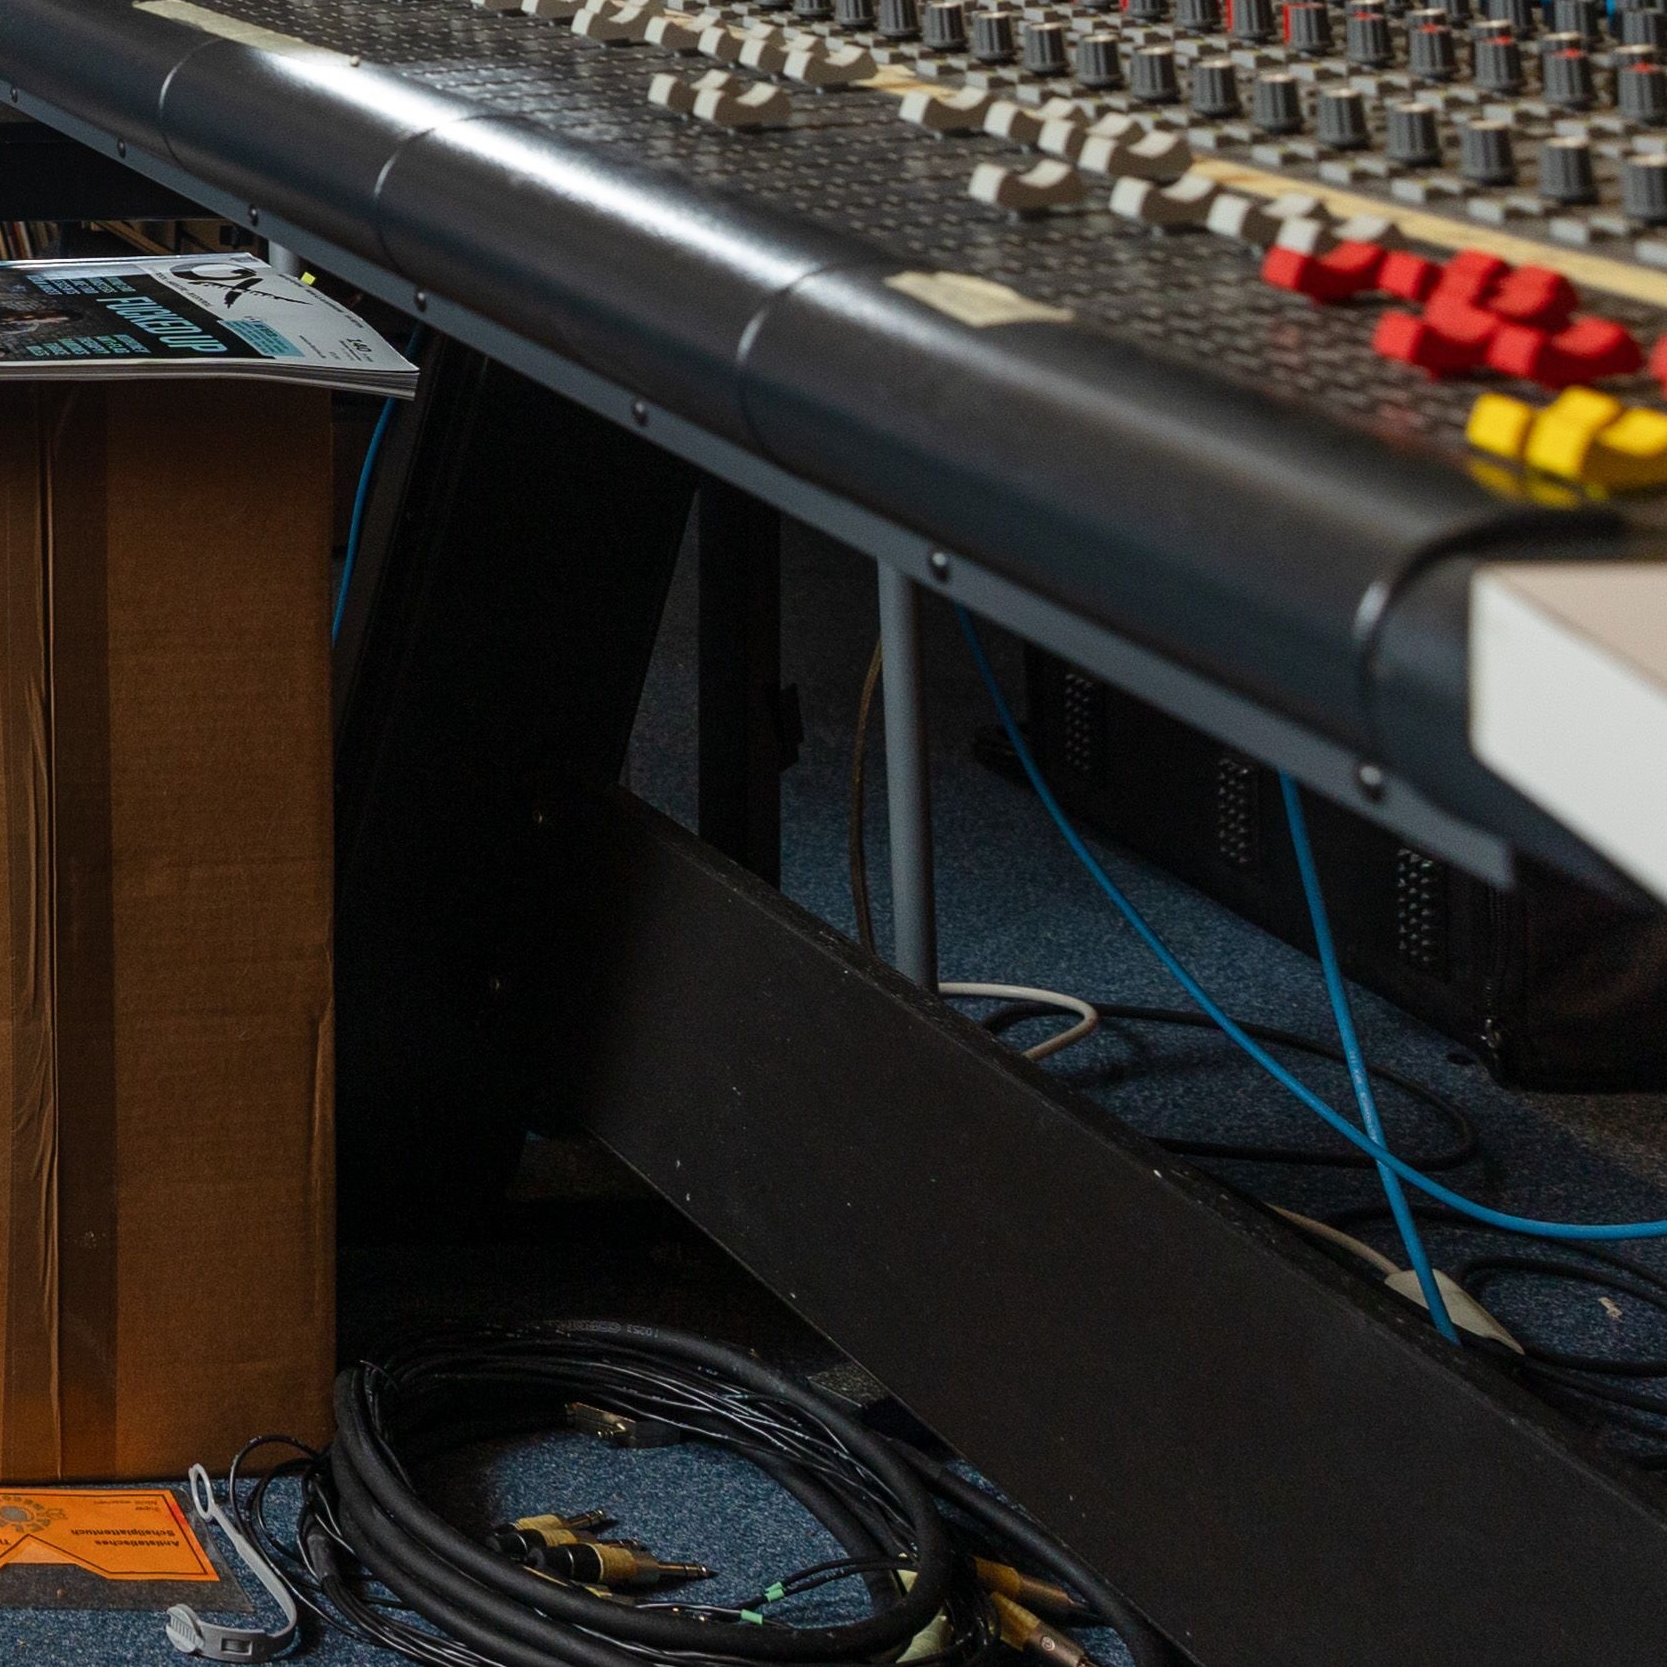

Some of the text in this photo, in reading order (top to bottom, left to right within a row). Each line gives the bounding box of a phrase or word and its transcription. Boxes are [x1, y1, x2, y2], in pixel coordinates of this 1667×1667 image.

[96, 296, 204, 334] FUCKED
[160, 336, 229, 353] UP
[95, 1539, 180, 1547] Antistatisches
